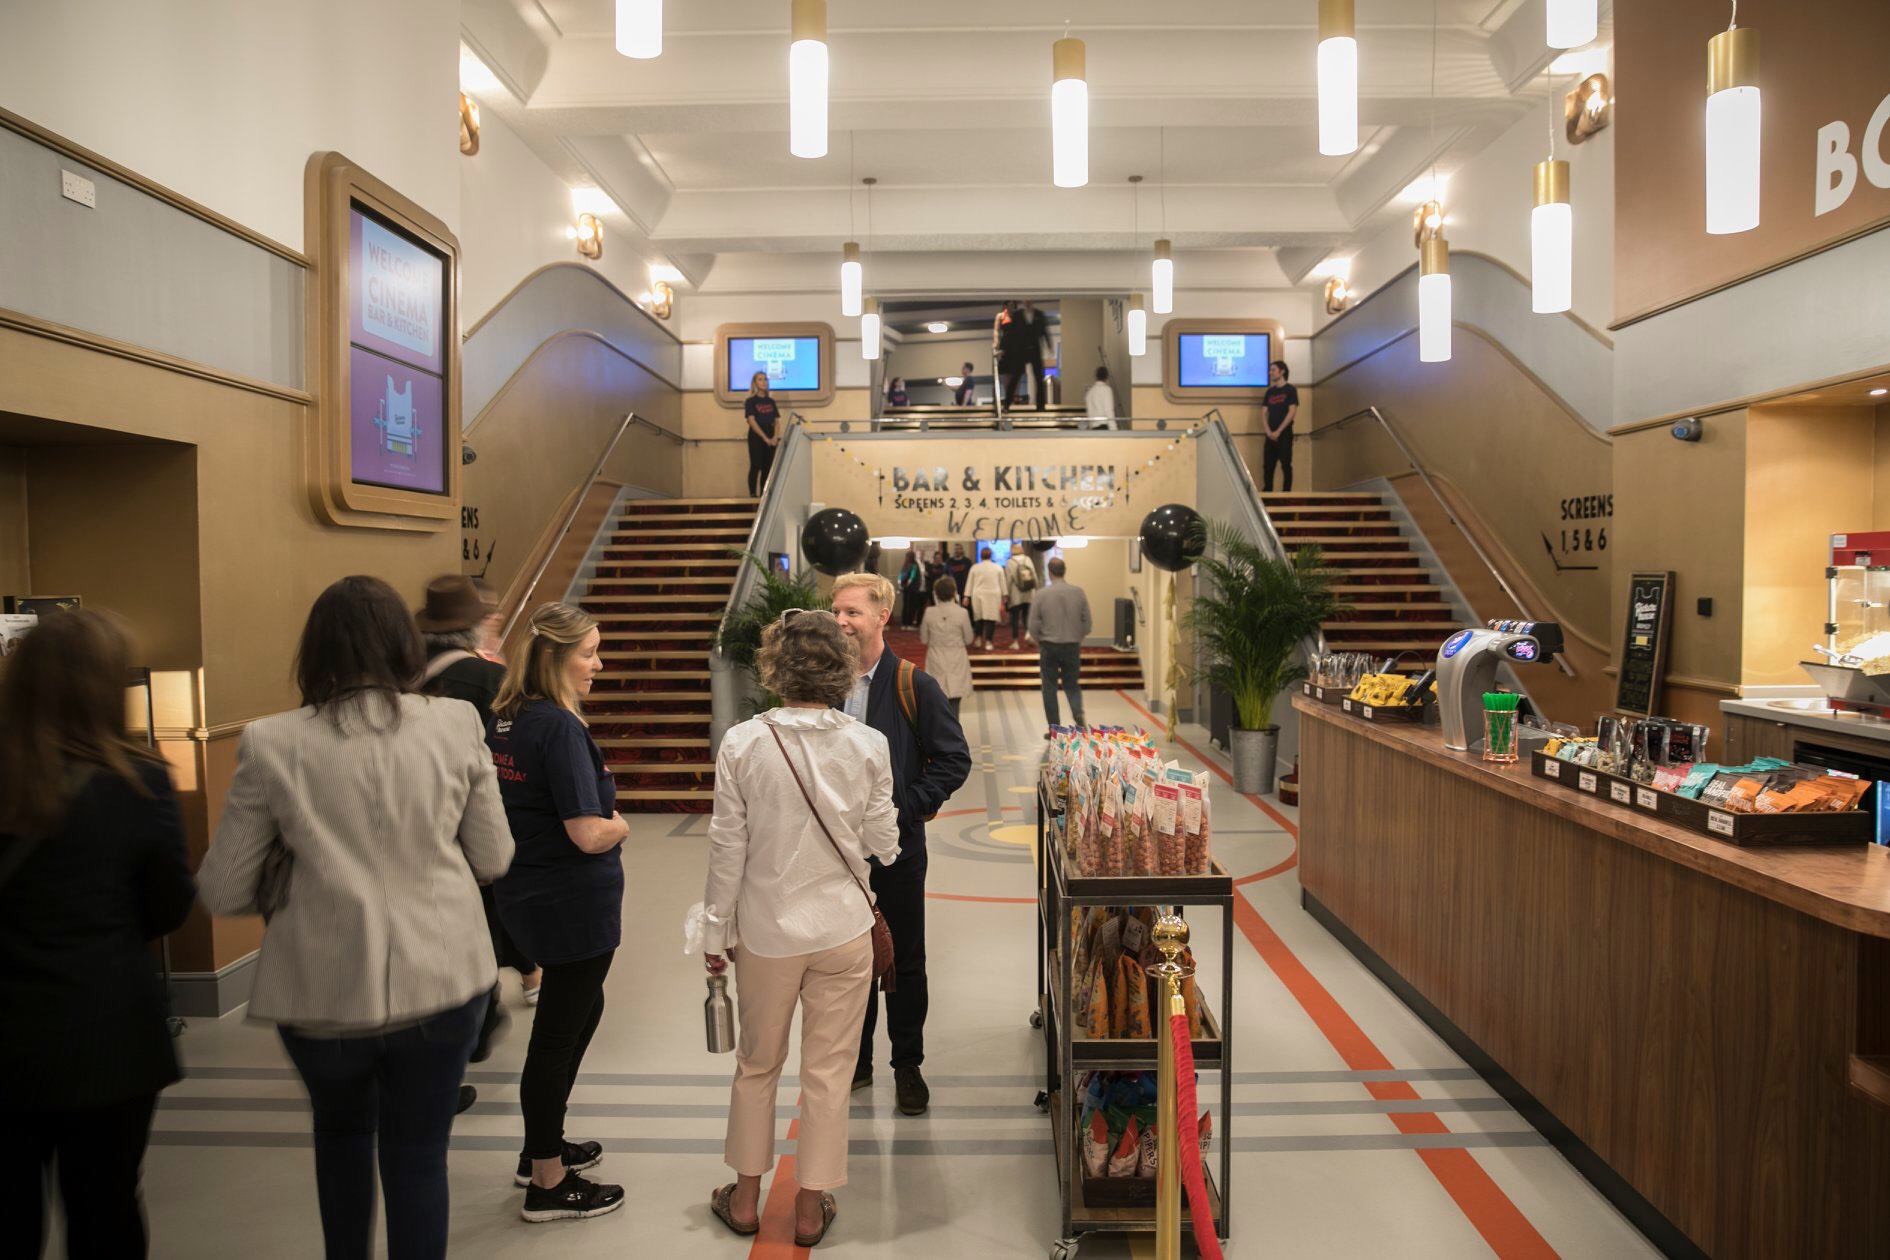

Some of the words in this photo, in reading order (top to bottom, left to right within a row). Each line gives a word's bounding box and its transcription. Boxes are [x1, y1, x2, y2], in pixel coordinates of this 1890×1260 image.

[368, 241, 428, 290] WELCOME
[368, 276, 428, 325] CINEMA
[368, 304, 386, 325] BAR
[387, 312, 393, 328] &
[394, 314, 429, 343] KITCHEN
[892, 466, 949, 492] BAR
[962, 466, 980, 491] &
[994, 465, 1115, 491] KITCHEN
[995, 497, 1041, 508] TOILETS
[1047, 497, 1054, 507] &
[1561, 494, 1613, 521] SCREENS
[947, 504, 1086, 545] WELCOME
[463, 538, 470, 560] &
[473, 539, 479, 560] 6
[1573, 529, 1580, 551] 5
[1584, 529, 1593, 551] &
[1597, 528, 1607, 550] 6
